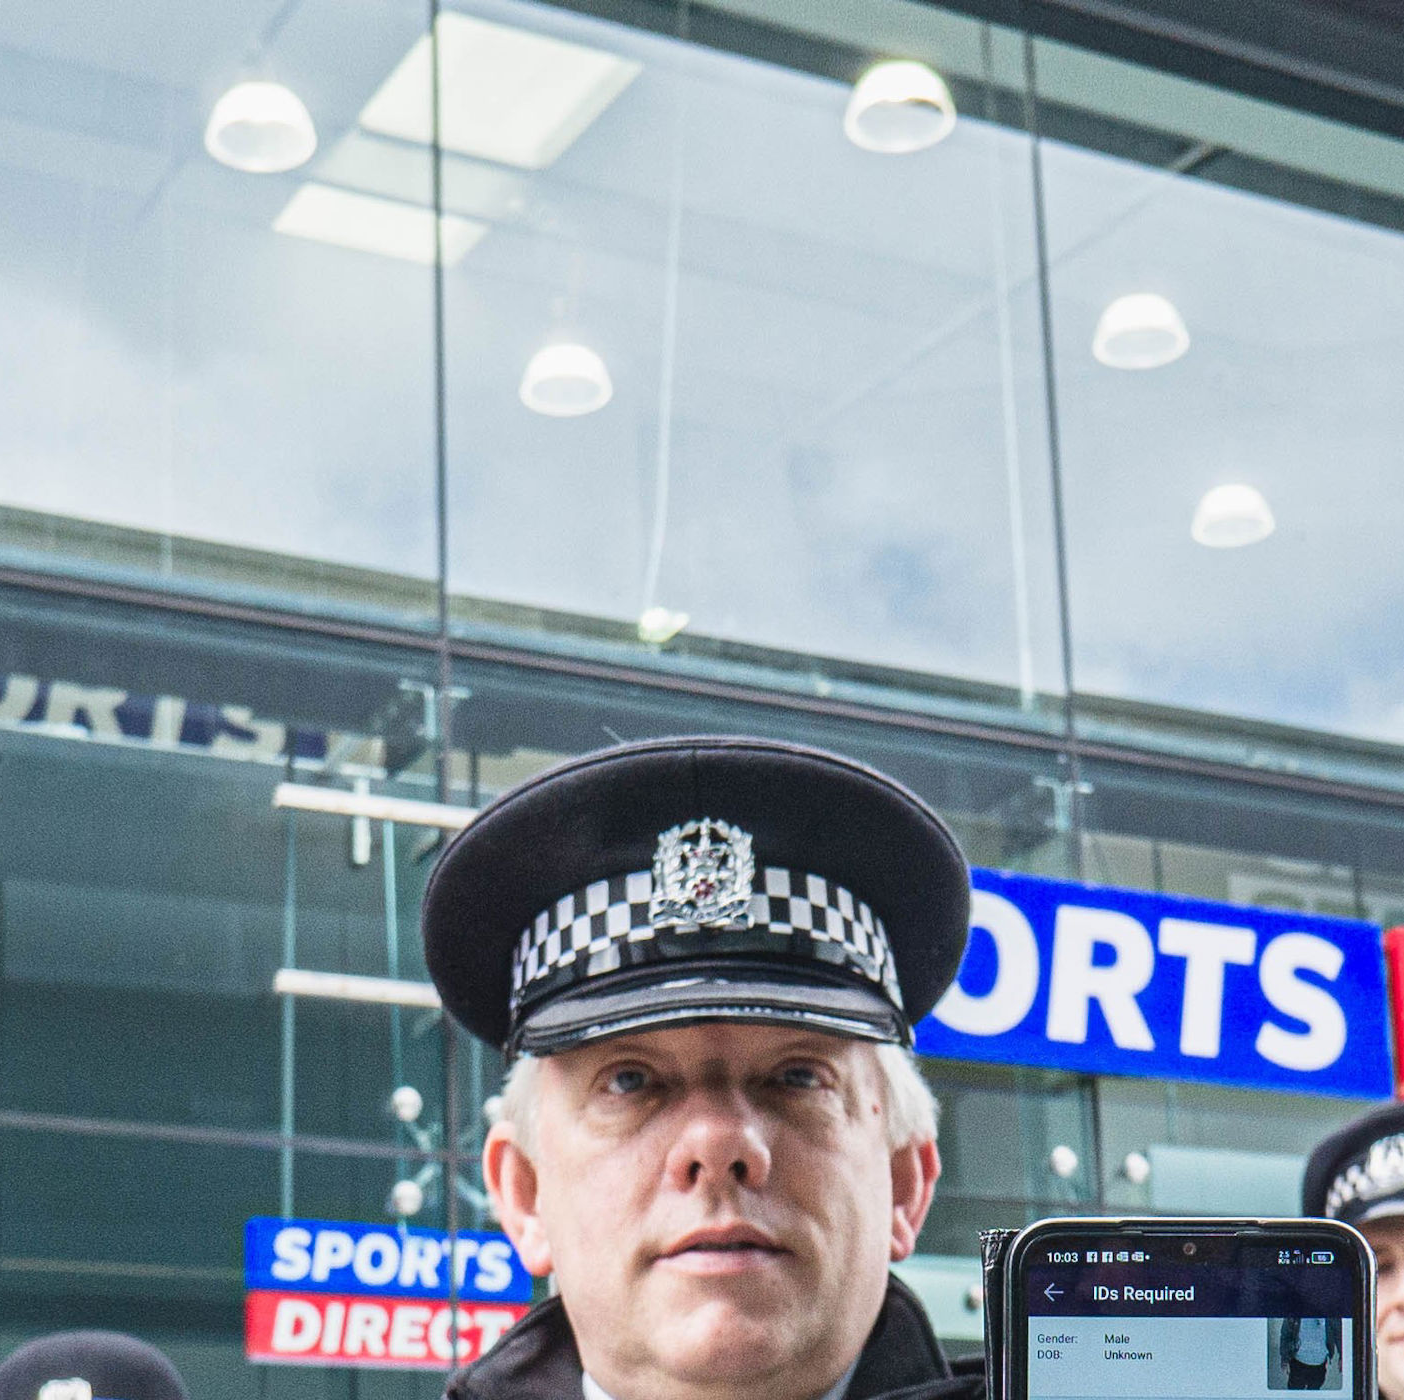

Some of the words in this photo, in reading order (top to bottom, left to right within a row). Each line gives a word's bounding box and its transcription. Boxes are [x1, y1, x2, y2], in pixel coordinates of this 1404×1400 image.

[930, 888, 1348, 1073] ORTS
[271, 1227, 514, 1292] SPORTS
[1047, 1252, 1079, 1263] 10:03
[1093, 1286, 1119, 1301] IDs
[1123, 1285, 1195, 1304] Required
[1037, 1334, 1078, 1344] Gender:
[1104, 1334, 1130, 1344] Male
[1037, 1350, 1063, 1360] DOB:
[1104, 1350, 1153, 1360] Unknown
